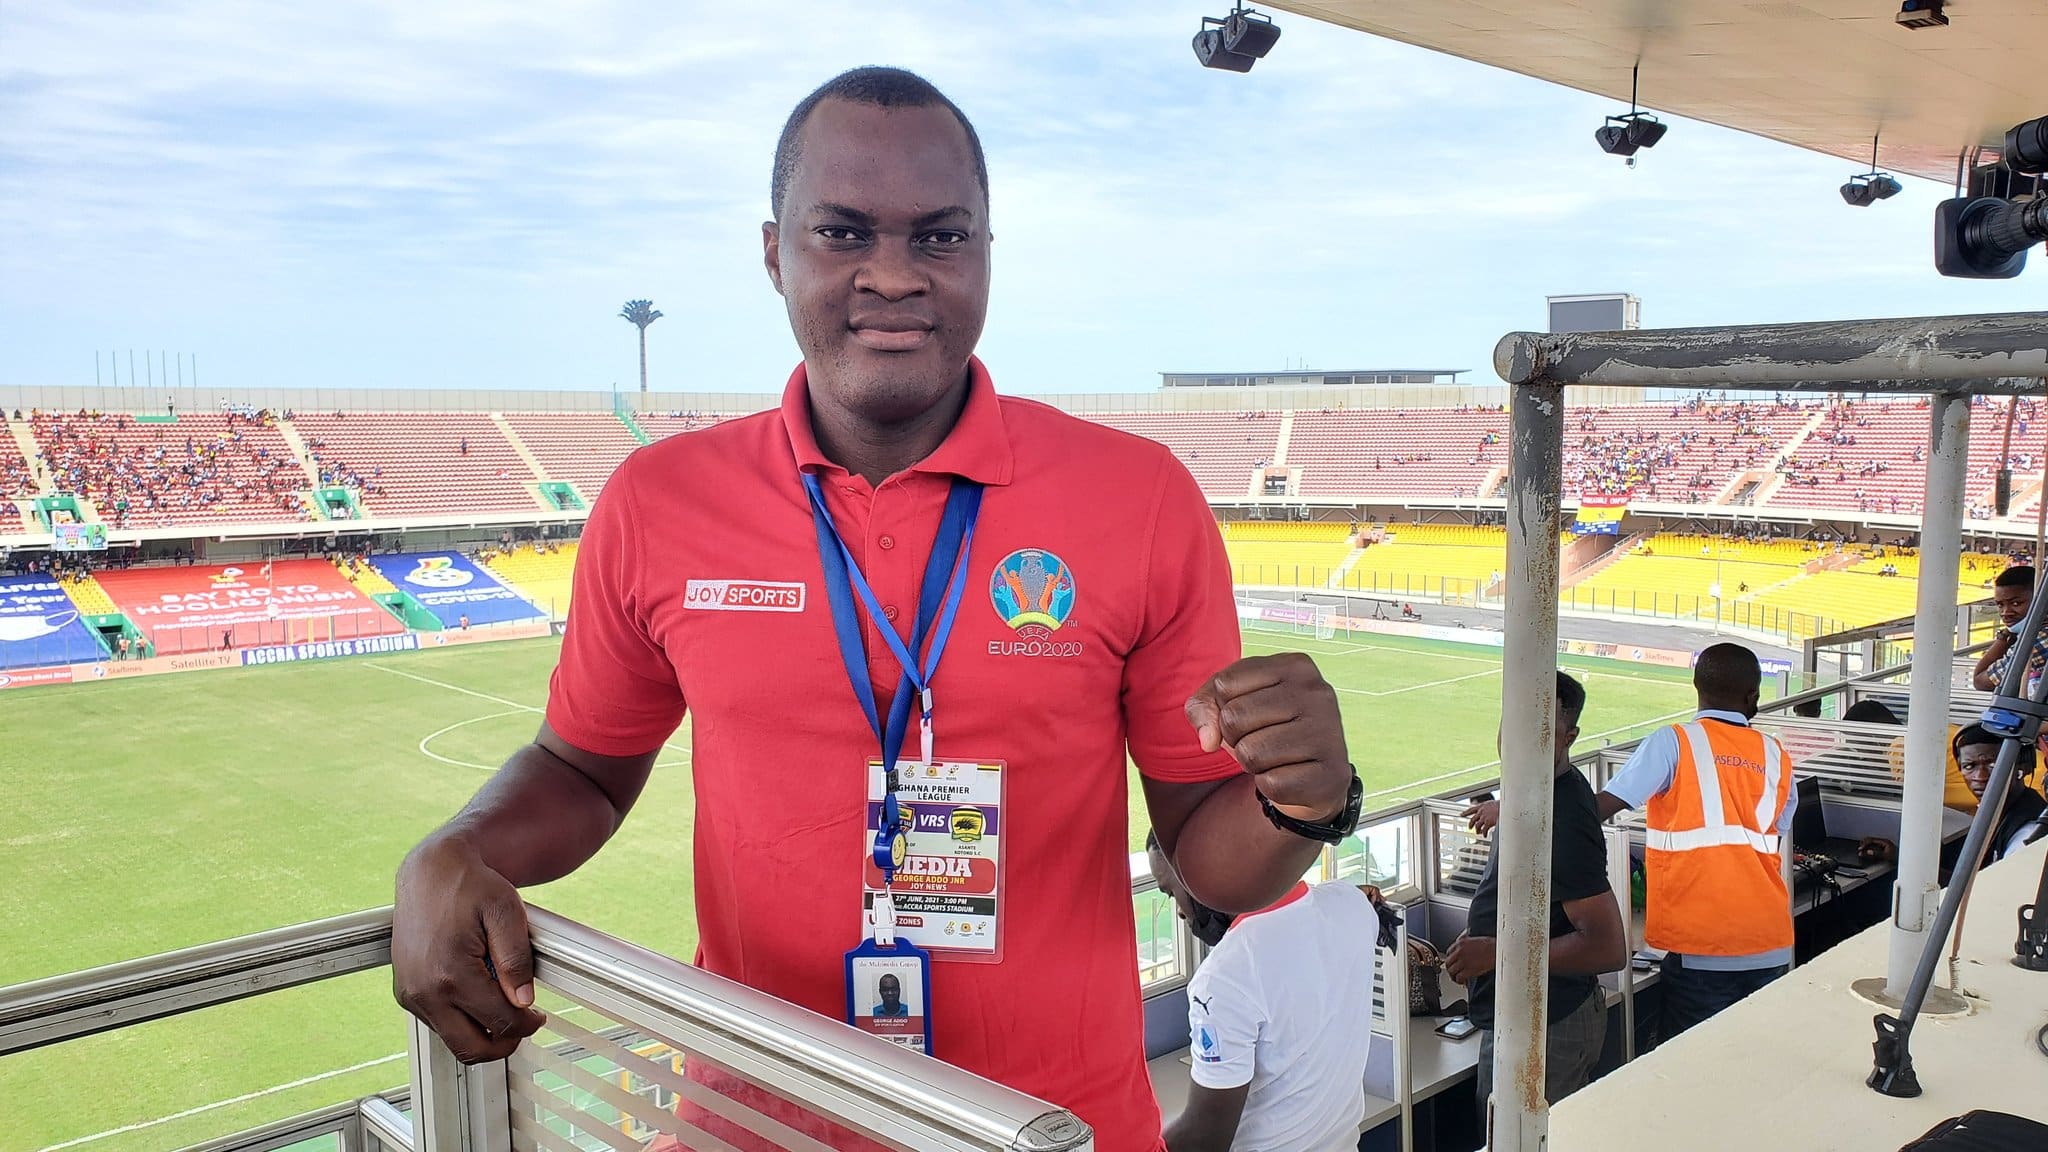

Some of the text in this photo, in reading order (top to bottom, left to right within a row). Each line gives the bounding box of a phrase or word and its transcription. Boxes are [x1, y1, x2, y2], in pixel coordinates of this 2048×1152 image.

[10, 595, 66, 604] Your
[160, 585, 319, 602] SAY NO TO
[688, 587, 797, 605] JOY SPORTS
[136, 591, 357, 615] HOOLIGANISM
[1017, 627, 1050, 640] UEFA
[247, 634, 415, 665] ACCRA SPORTS STADIUM
[170, 656, 231, 670] Satellite TV
[1715, 755, 1750, 768] ASEDA
[898, 784, 970, 794] GHANA PREMIER
[917, 793, 952, 801] LEAGUE
[920, 814, 945, 827] VRS
[893, 874, 965, 885] GEORGE ADDO JNR
[926, 883, 947, 891] NEWS
[903, 903, 923, 911] ACCRA
[946, 905, 974, 913] STADIUM
